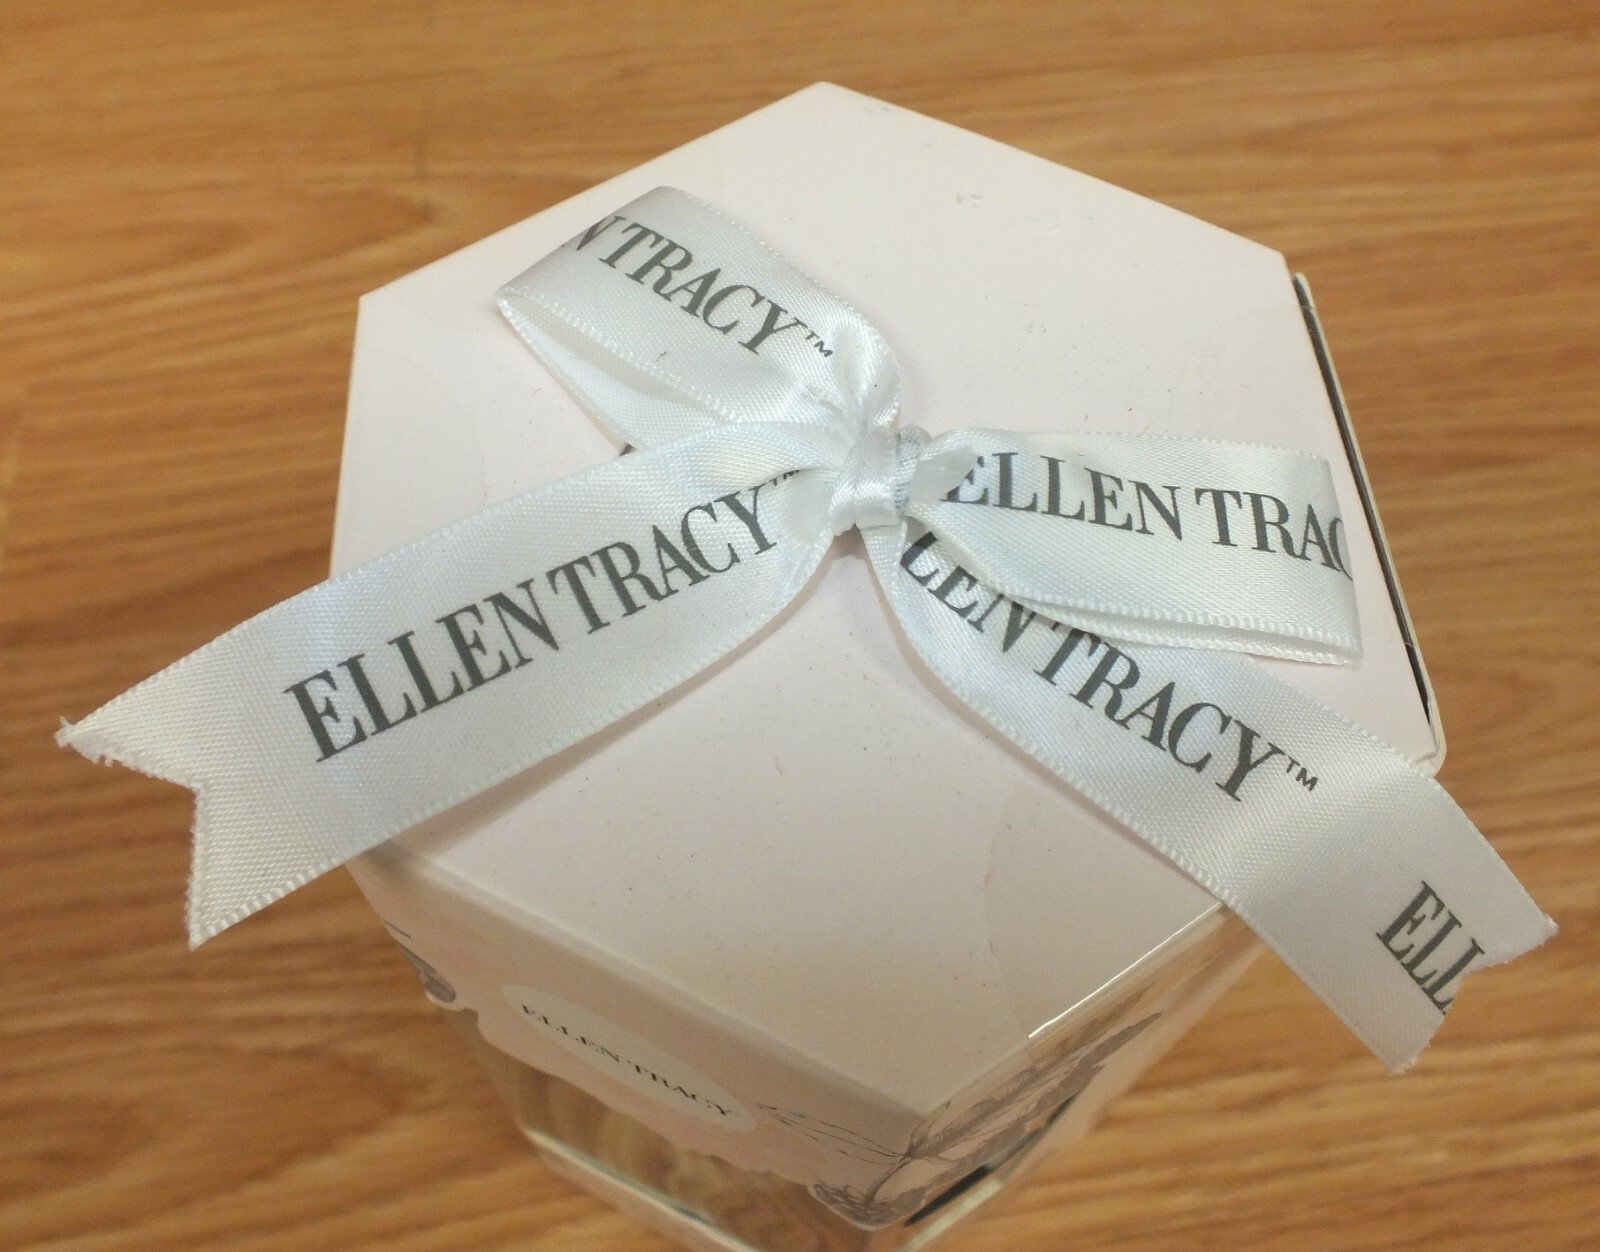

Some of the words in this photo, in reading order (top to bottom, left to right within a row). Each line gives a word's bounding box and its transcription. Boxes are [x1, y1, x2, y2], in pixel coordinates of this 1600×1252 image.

[283, 578, 559, 763] ELLEN
[521, 1004, 620, 1063] ELLEN
[626, 1059, 740, 1117] TRACY
